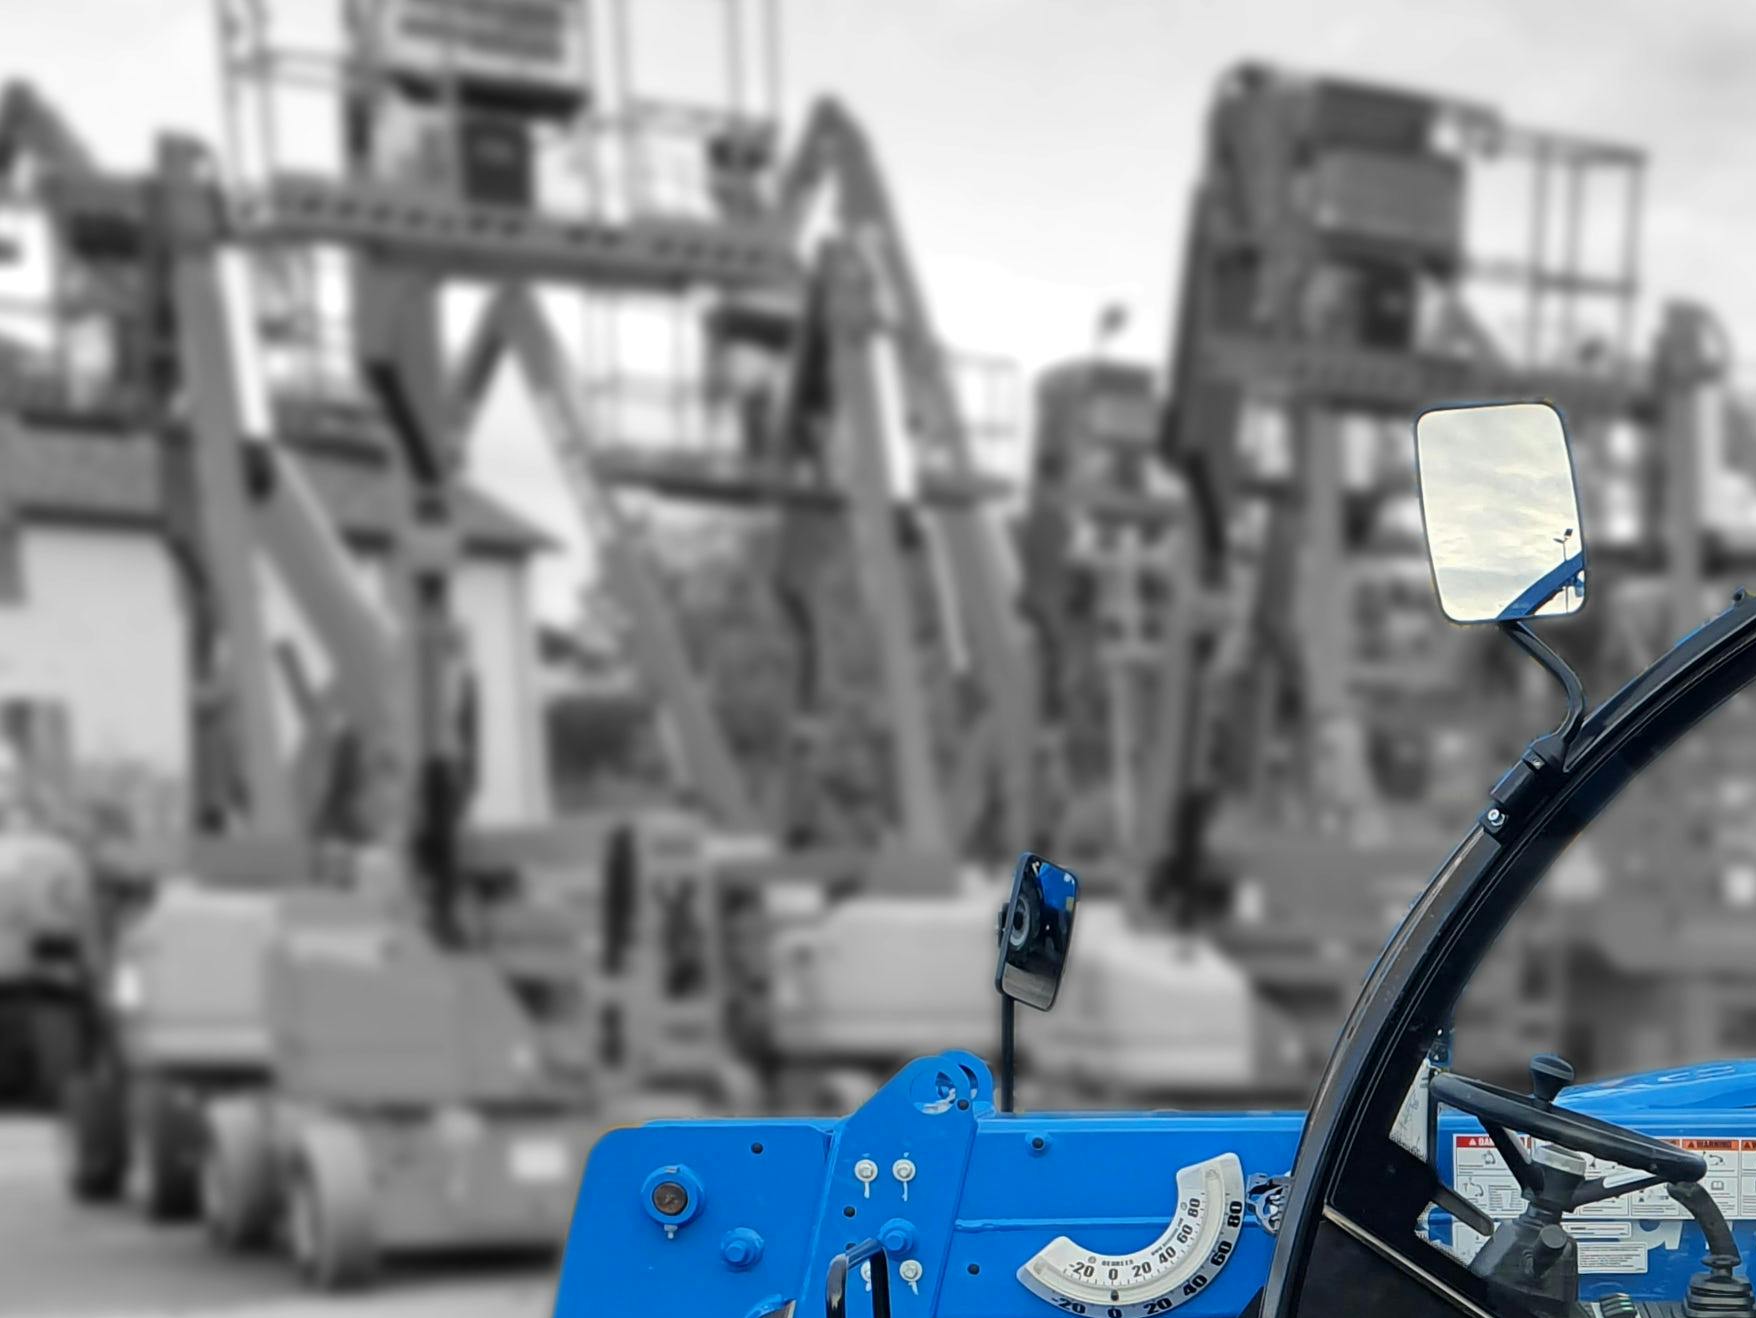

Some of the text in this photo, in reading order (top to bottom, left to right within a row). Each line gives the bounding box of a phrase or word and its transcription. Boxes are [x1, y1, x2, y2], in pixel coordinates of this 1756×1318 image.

[1051, 1201, 1242, 1318] -20 0 20 40 60 80
[1068, 1262, 1094, 1278] -20
[1108, 1268, 1118, 1280] 0
[1132, 1262, 1152, 1277] 20
[1158, 1246, 1176, 1265] 40
[1177, 1224, 1193, 1243] 60
[1187, 1197, 1201, 1218] 80
